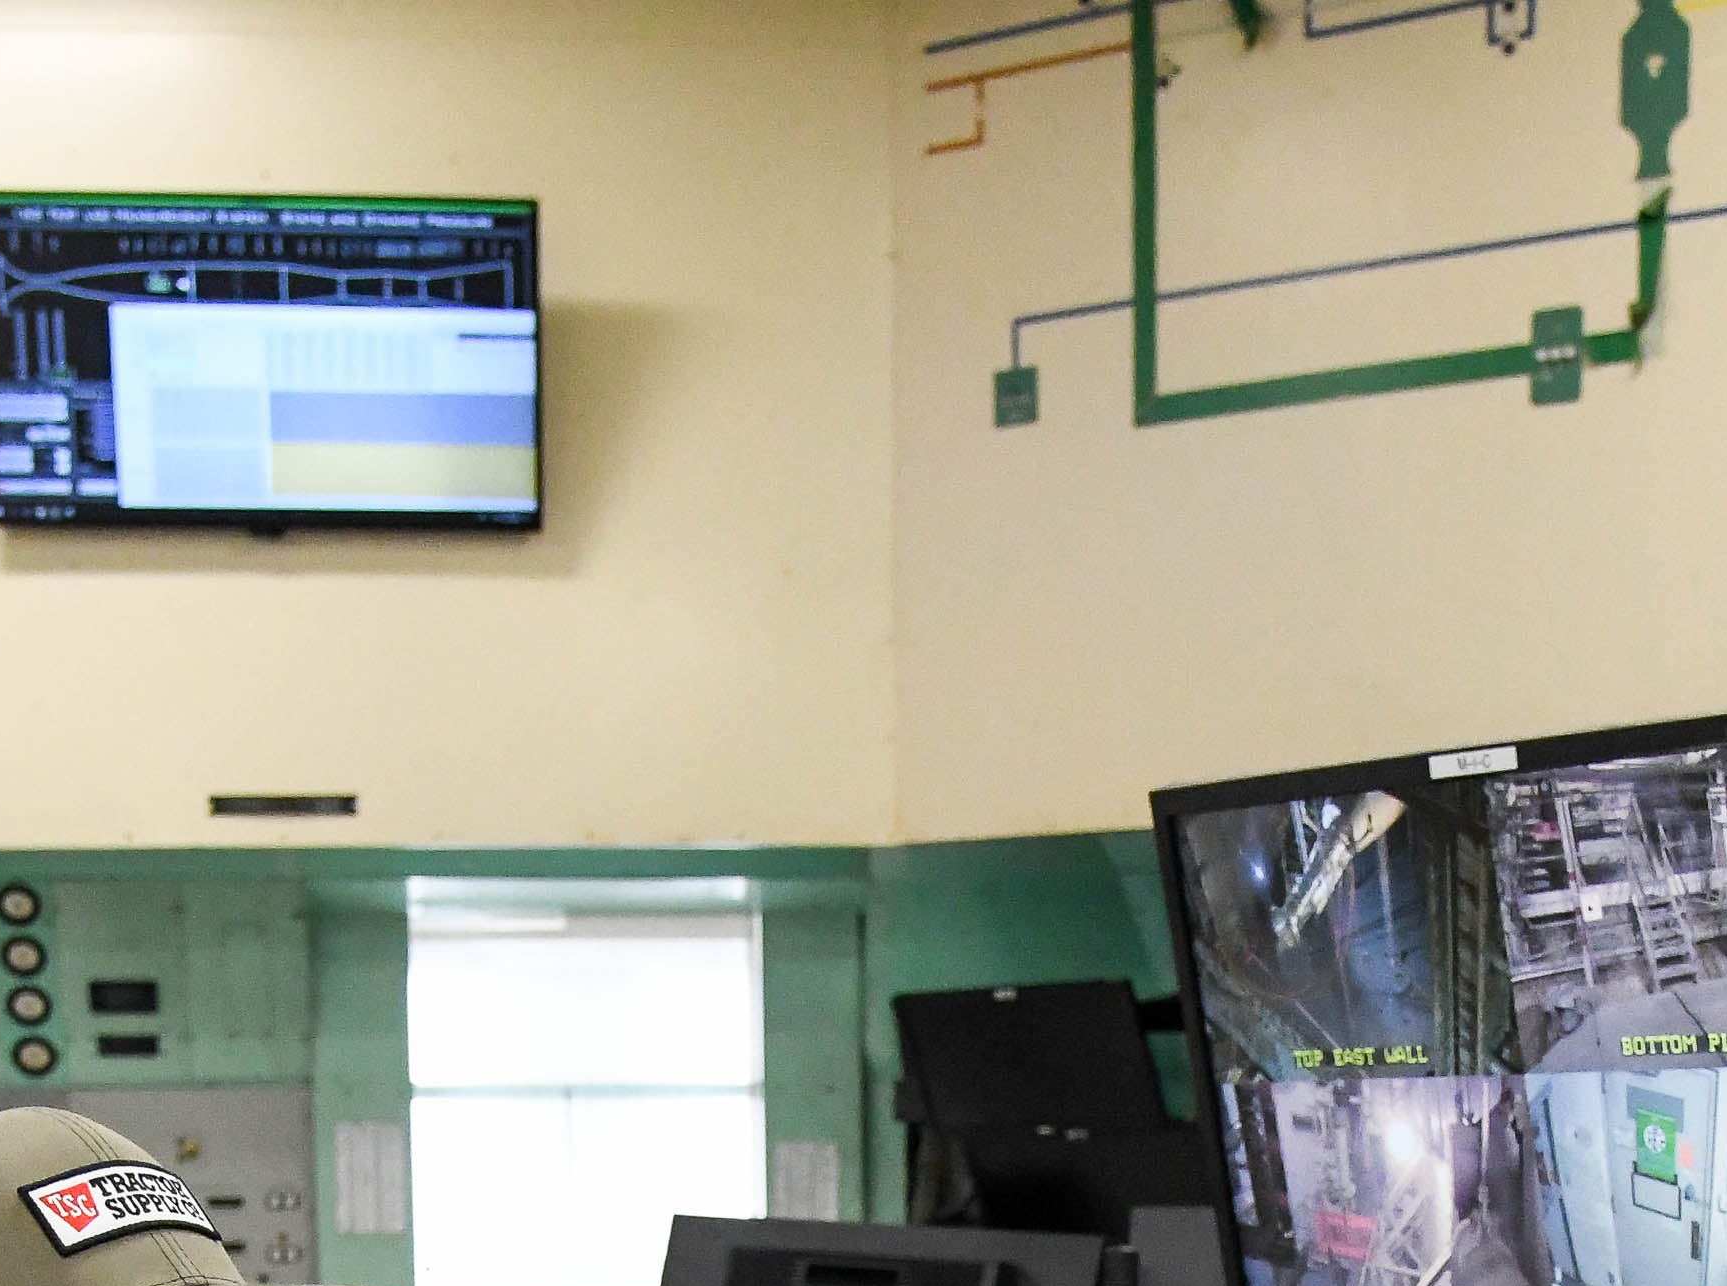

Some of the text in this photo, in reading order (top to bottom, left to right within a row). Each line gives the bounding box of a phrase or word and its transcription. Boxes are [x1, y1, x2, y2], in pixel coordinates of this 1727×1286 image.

[1293, 1045, 1429, 1069] TOP EAST WALL
[1621, 1033, 1698, 1056] BOTTOM
[88, 1172, 188, 1200] TRACTOR
[47, 1192, 97, 1218] TSC
[105, 1193, 185, 1220] SUPPLY
